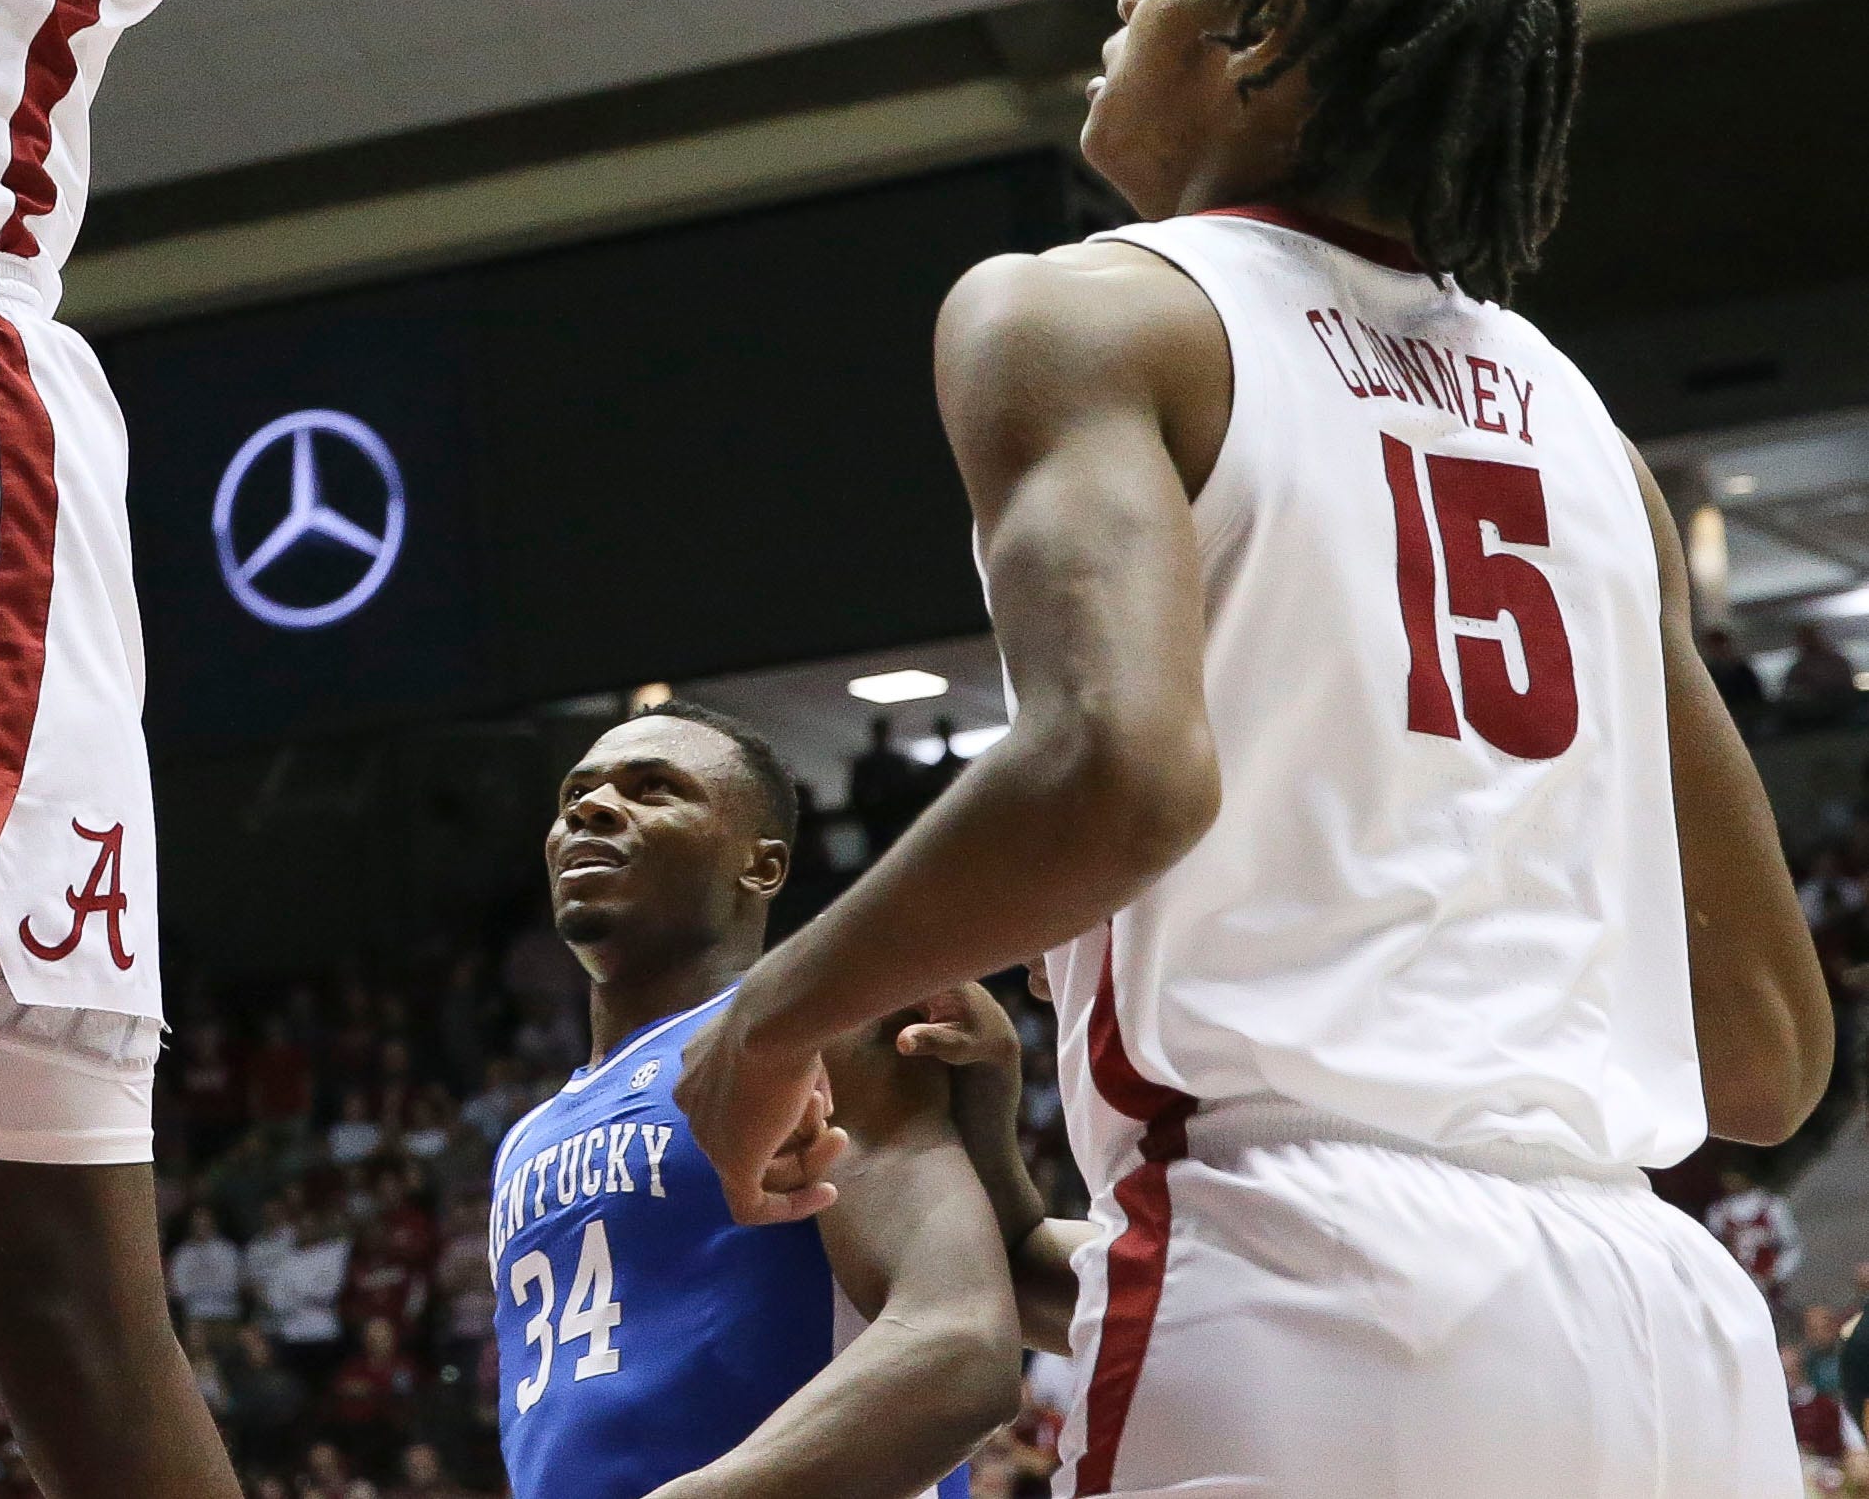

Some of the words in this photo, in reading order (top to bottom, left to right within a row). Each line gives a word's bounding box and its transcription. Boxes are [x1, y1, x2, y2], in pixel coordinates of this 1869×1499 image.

[1306, 308, 1533, 445] CLOWNEY
[1380, 431, 1579, 760] 15
[510, 1220, 622, 1414] 34
